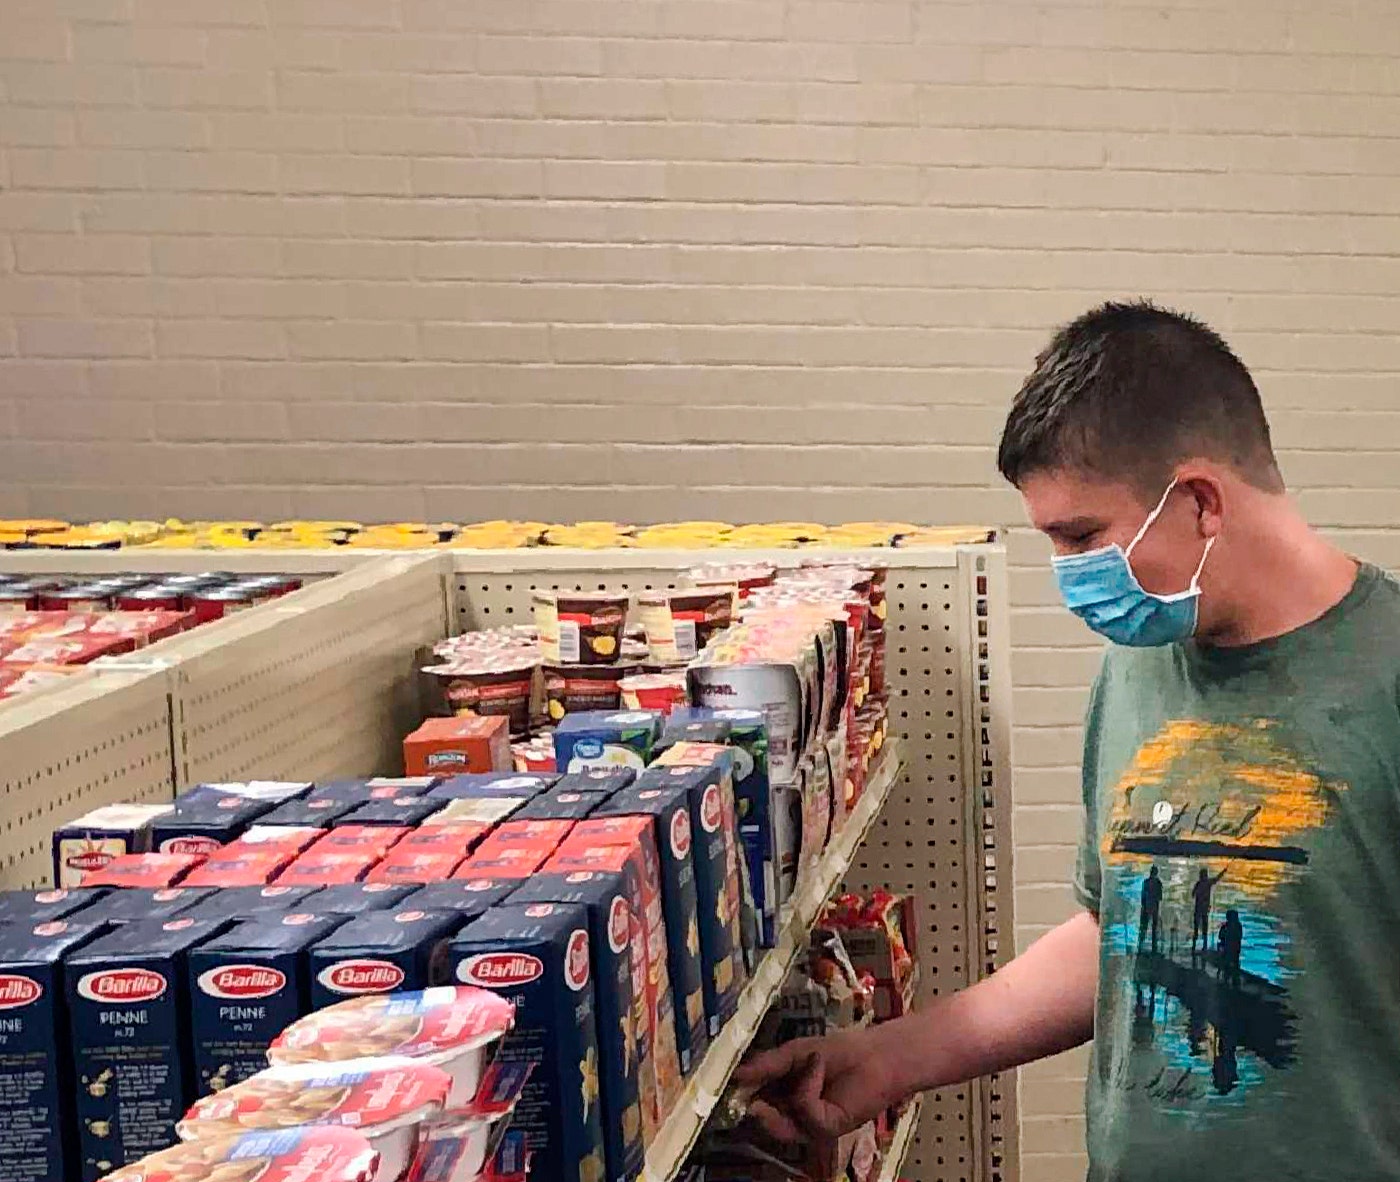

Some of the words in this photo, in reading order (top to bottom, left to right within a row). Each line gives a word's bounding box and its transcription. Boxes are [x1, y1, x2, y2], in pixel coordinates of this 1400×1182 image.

[338, 969, 398, 985] Barilla
[477, 960, 537, 978] Barilla
[98, 976, 160, 994] Barilla
[218, 973, 278, 988] Barilla
[0, 981, 32, 1000] rilla
[100, 1009, 149, 1025] PENNE
[220, 1006, 267, 1020] PENNE
